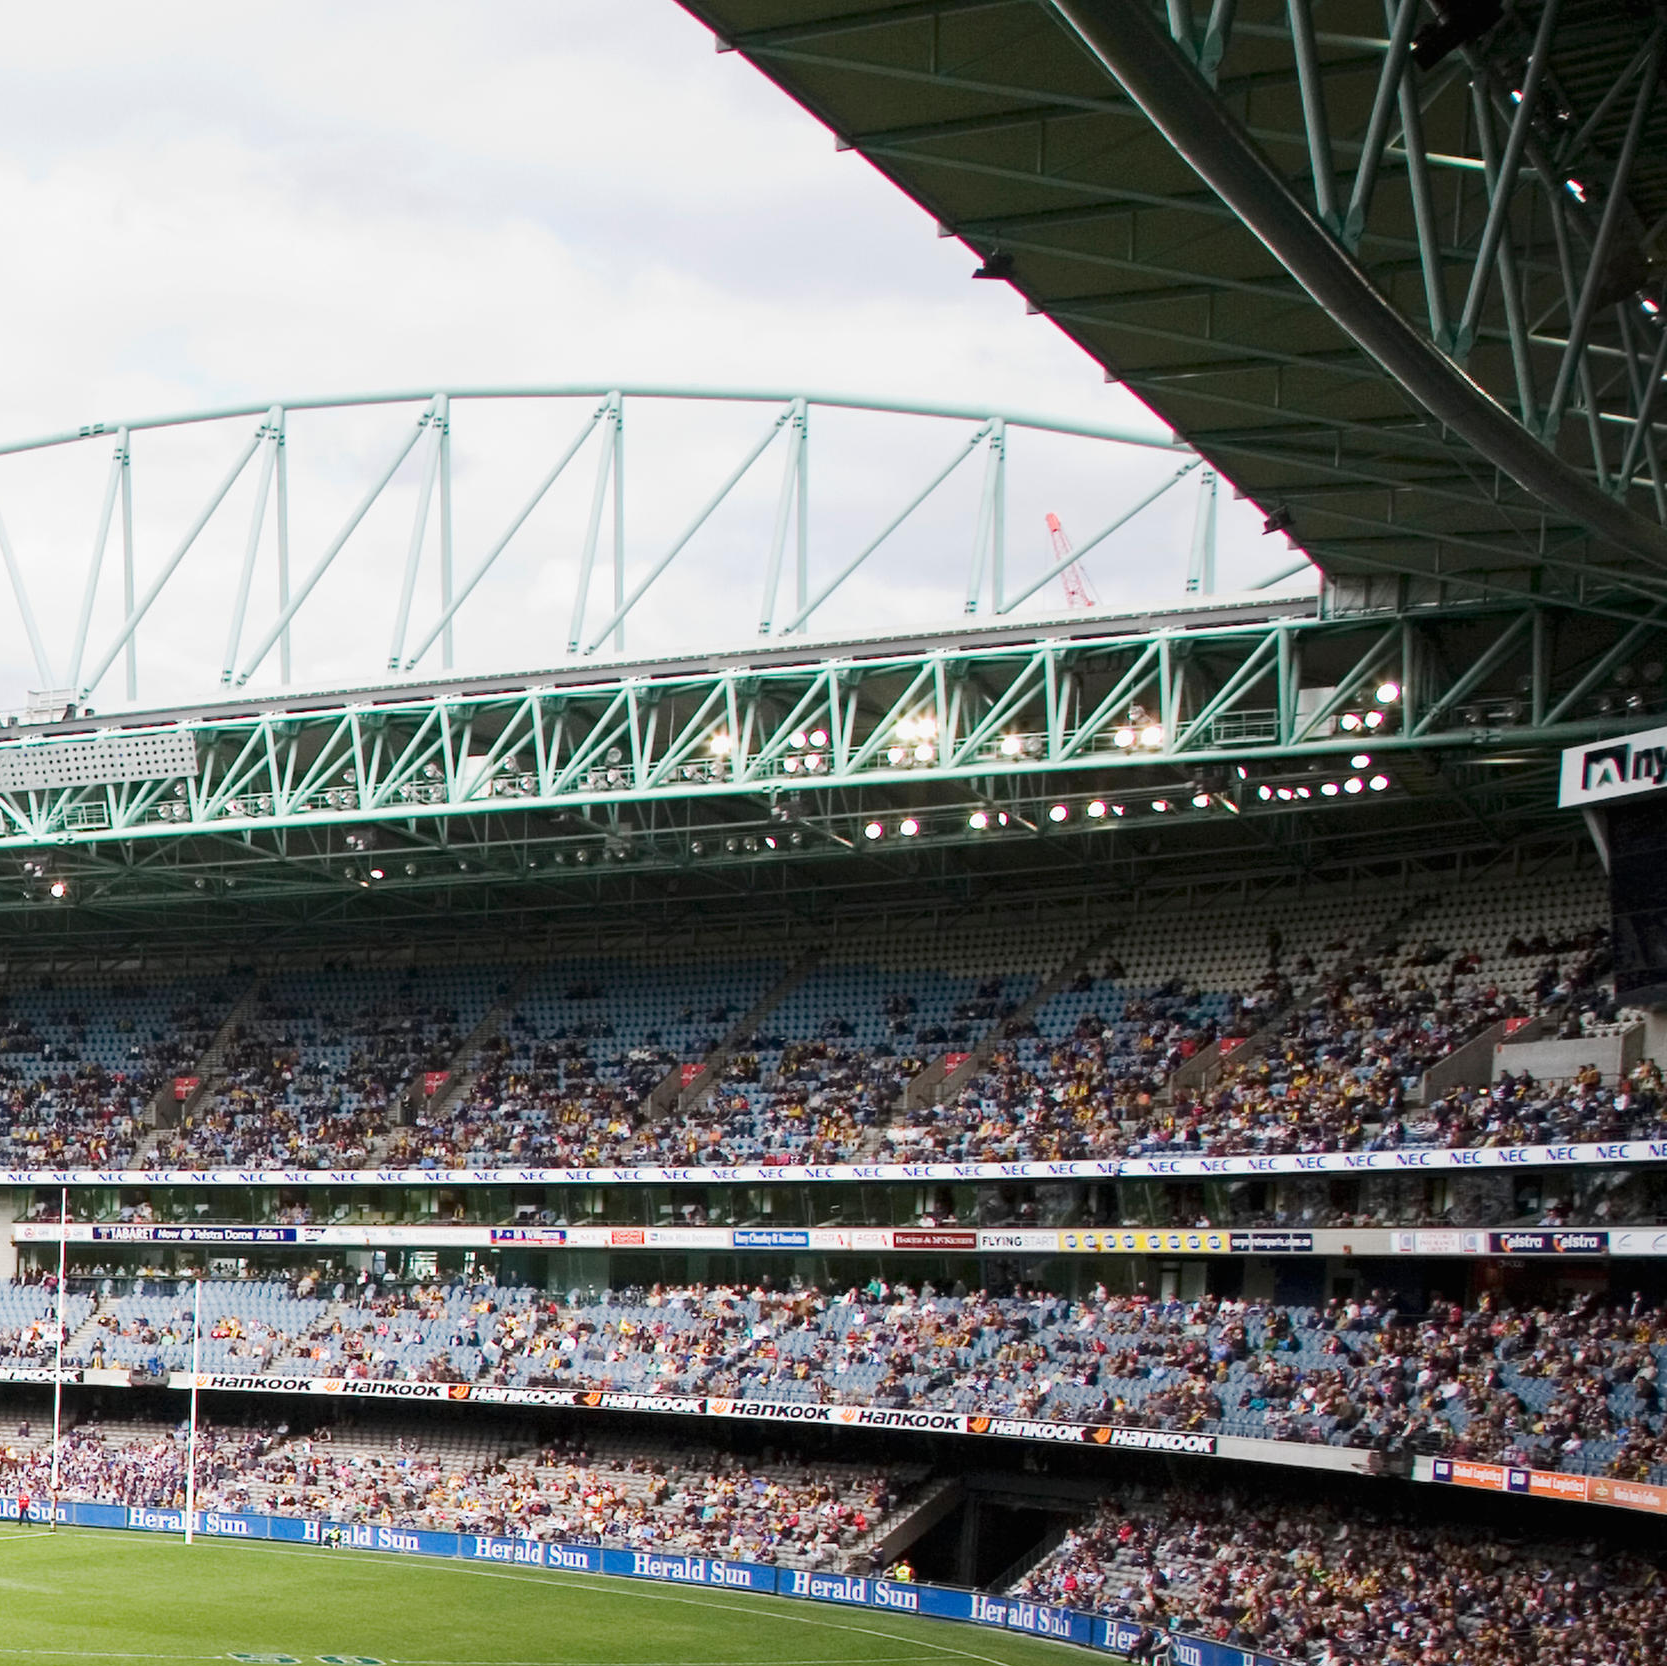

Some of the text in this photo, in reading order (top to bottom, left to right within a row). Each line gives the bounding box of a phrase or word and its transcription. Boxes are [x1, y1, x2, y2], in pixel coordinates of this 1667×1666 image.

[144, 1172, 175, 1183] NEC
[330, 1172, 361, 1183] NEC
[565, 1170, 596, 1181] NEC
[758, 1167, 787, 1179] NEC
[953, 1164, 985, 1177] NEC
[1200, 1159, 1233, 1172] NEC
[1397, 1152, 1432, 1166] NEC
[1596, 1144, 1631, 1159] NEC
[982, 1235, 1022, 1247] FLYING
[1500, 1234, 1544, 1252] Telstra
[1552, 1234, 1599, 1253] Telstra
[27, 1501, 67, 1521] Sun
[206, 1513, 248, 1535] Sun
[378, 1528, 420, 1551] Sun
[474, 1537, 589, 1569] Herald Sun
[633, 1553, 752, 1586] Herald Sun
[793, 1571, 919, 1610] Herald Sun
[970, 1594, 1035, 1629] Herald
[1038, 1606, 1071, 1638] Sun
